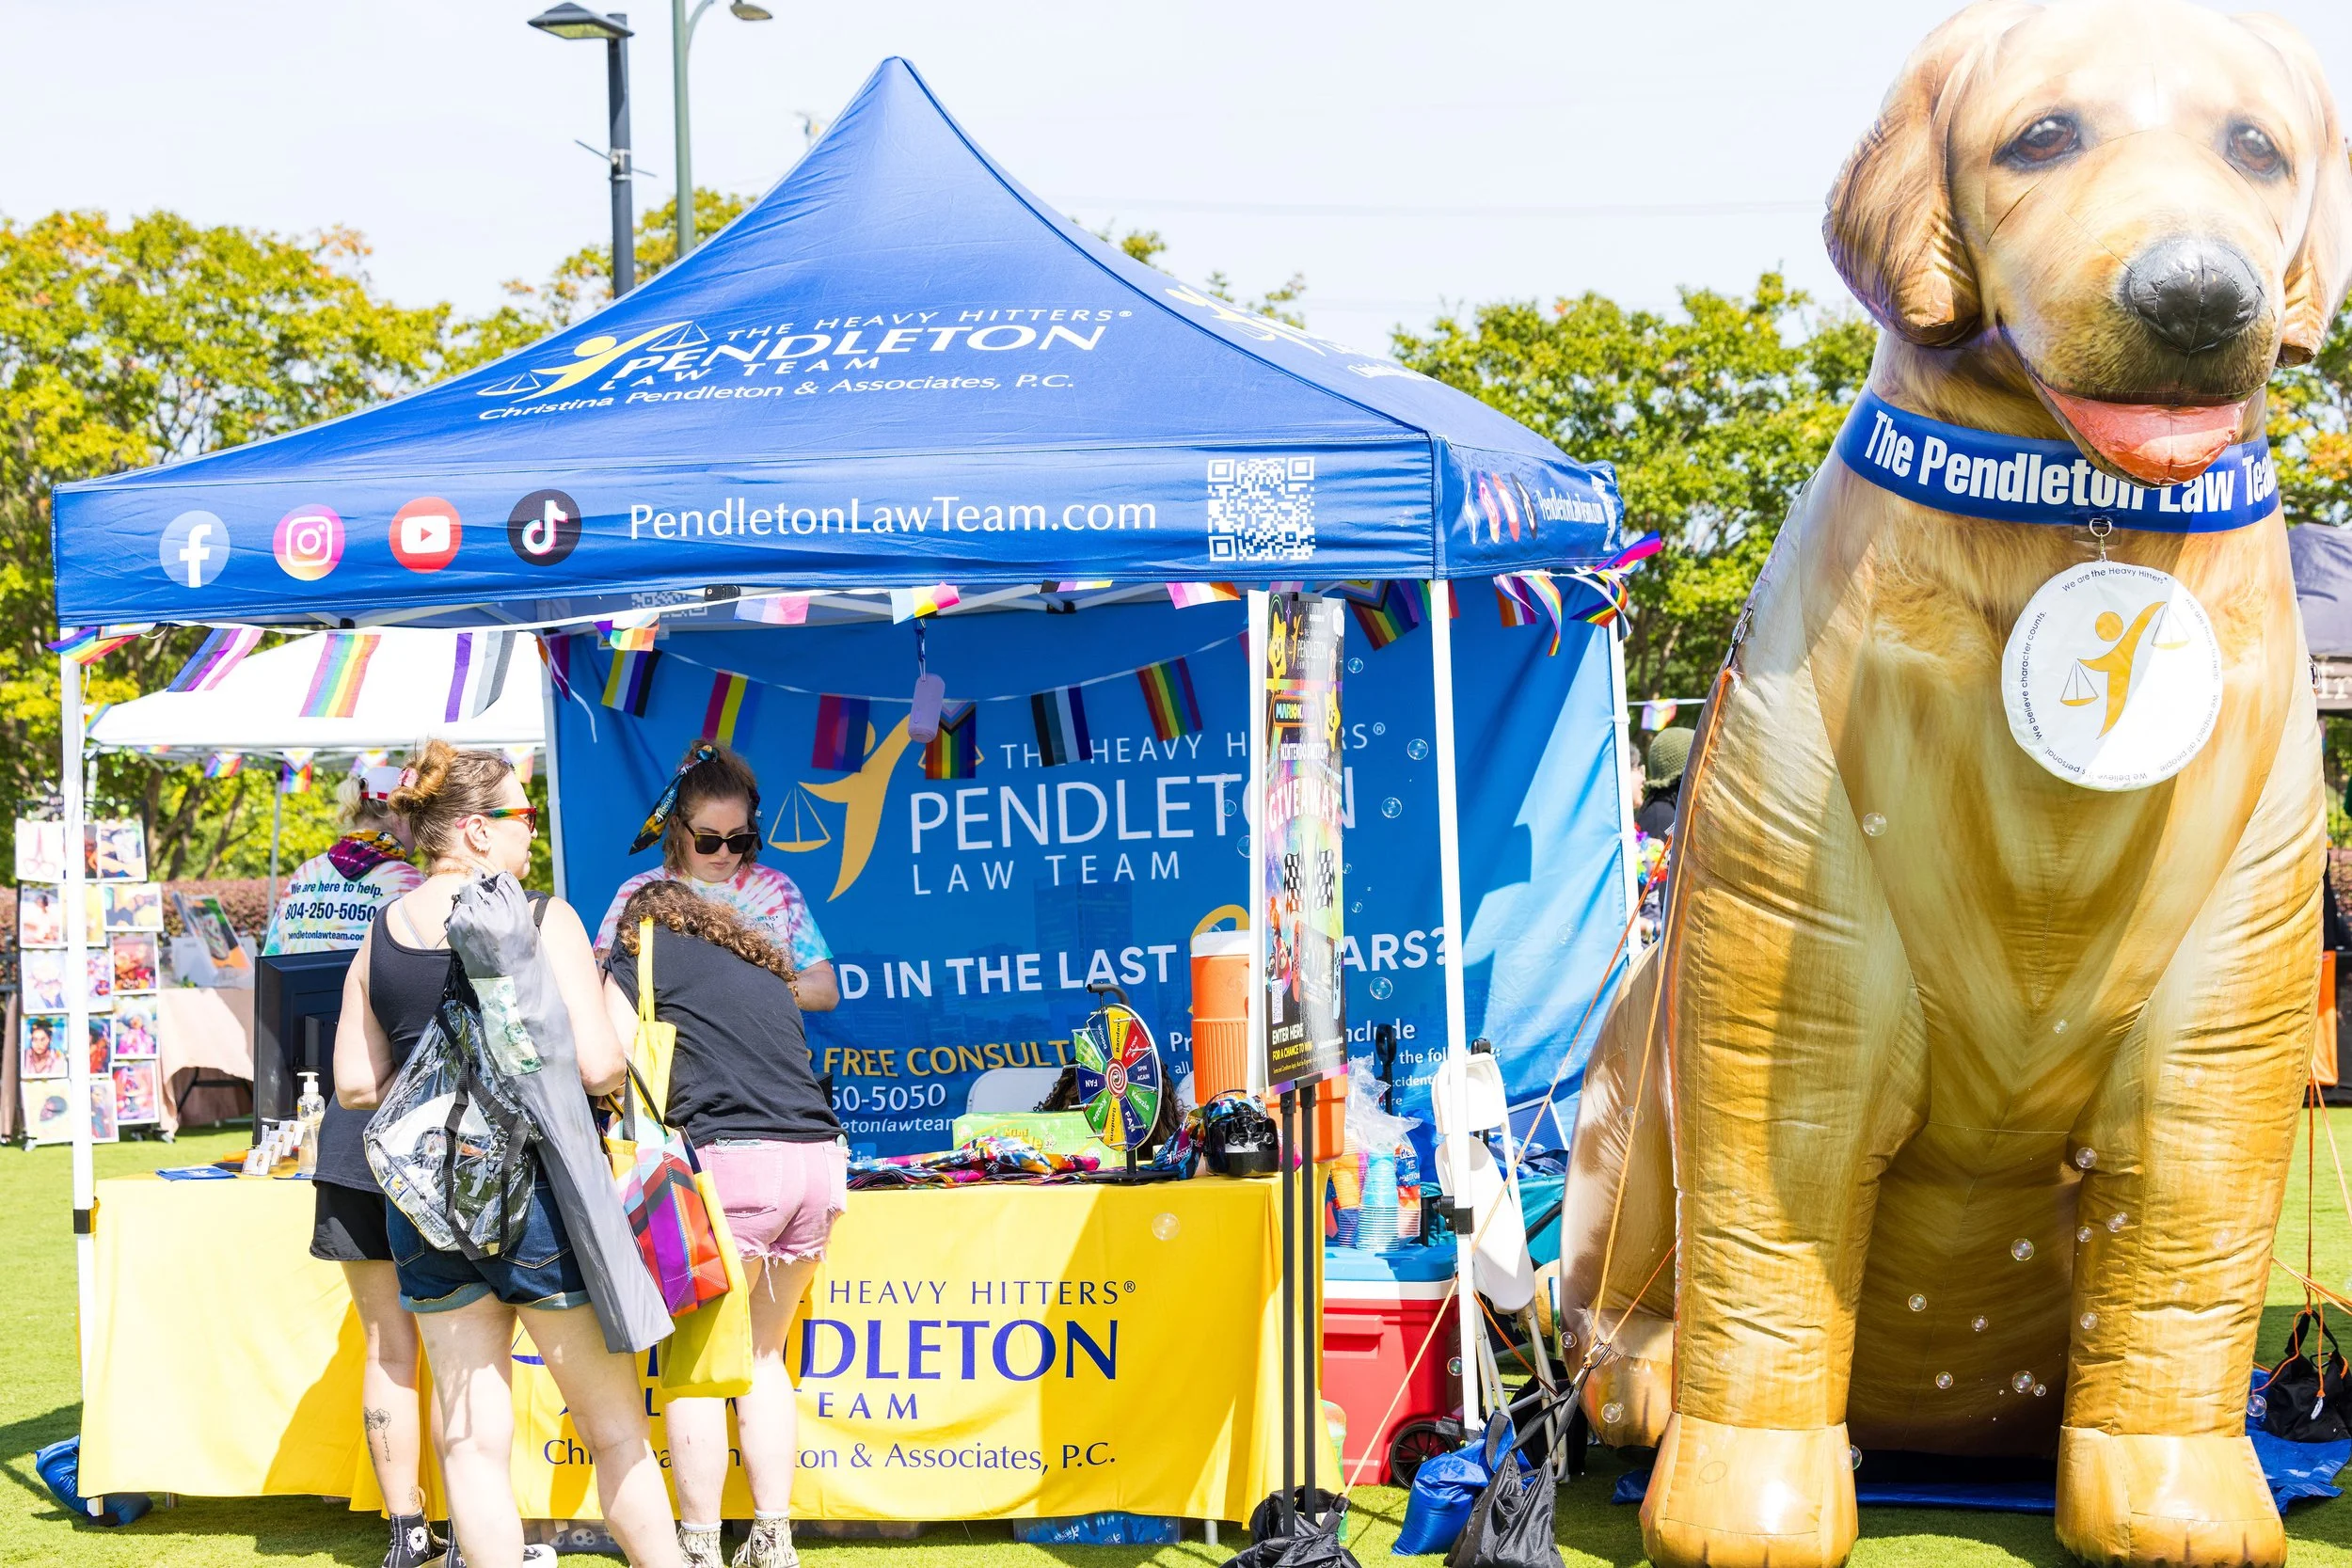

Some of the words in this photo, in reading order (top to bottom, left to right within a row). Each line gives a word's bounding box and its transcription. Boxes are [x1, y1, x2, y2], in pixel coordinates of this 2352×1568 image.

[726, 322, 794, 341] THE
[814, 311, 939, 330] HEAVY
[612, 325, 1107, 379] PENDLETON
[598, 368, 711, 391] LAW
[742, 356, 880, 376] TEAM
[478, 395, 614, 420] Christina
[625, 385, 784, 404] Pendleton
[794, 381, 819, 396] &
[827, 375, 1002, 393] Associates,
[1014, 374, 1074, 388] P.C.
[1864, 409, 1915, 478] The
[1917, 435, 2145, 511] Pendleton
[2158, 469, 2235, 514] Law
[629, 495, 1157, 540] PendletonLawTeam.com
[2061, 580, 2076, 592] We
[2076, 574, 2090, 584] are
[2090, 569, 2106, 578] the
[2108, 567, 2137, 577] Heavy
[2027, 610, 2047, 641] counts.
[2020, 642, 2032, 688] character
[2022, 690, 2036, 725] believe
[2032, 724, 2042, 740] We
[2195, 710, 2214, 742] respect
[1089, 734, 1203, 764] HEAVY
[2186, 741, 2197, 753] all
[910, 766, 1357, 854] PENDLETN
[1268, 777, 1342, 832] GIVEAWAY
[912, 861, 1015, 896] LAW
[1044, 850, 1181, 887] TEAM
[291, 882, 302, 895] We
[302, 882, 316, 893] are
[317, 880, 340, 893] here
[343, 881, 355, 893] to
[357, 880, 384, 898] help.
[284, 902, 377, 923] 804-250-5050
[884, 959, 933, 1000] IN
[945, 954, 1043, 997] THE
[1058, 944, 1178, 990] LAST
[1343, 927, 1445, 973] ARS?
[1272, 1026, 1289, 1045] ENTER
[1289, 1022, 1304, 1041] HERE
[823, 1047, 898, 1077] FREE
[1272, 1050, 1280, 1062] FOR
[1283, 1044, 1299, 1058] CHANCE
[1298, 1042, 1305, 1053] TO
[1398, 1050, 1423, 1065] the
[1174, 1061, 1190, 1074] all
[832, 1083, 946, 1113] 50-5050
[1085, 1079, 1098, 1087] FAN
[1092, 1098, 1107, 1123] Koozie
[1131, 1089, 1151, 1112] Koozie
[1124, 1111, 1136, 1132] FAN
[830, 1279, 946, 1305] HEAVY
[787, 1319, 1118, 1381] DLETON
[793, 1388, 918, 1420] EAM
[850, 1442, 873, 1469] &
[883, 1442, 1049, 1476] Associates,
[1061, 1442, 1117, 1469] P.C.
